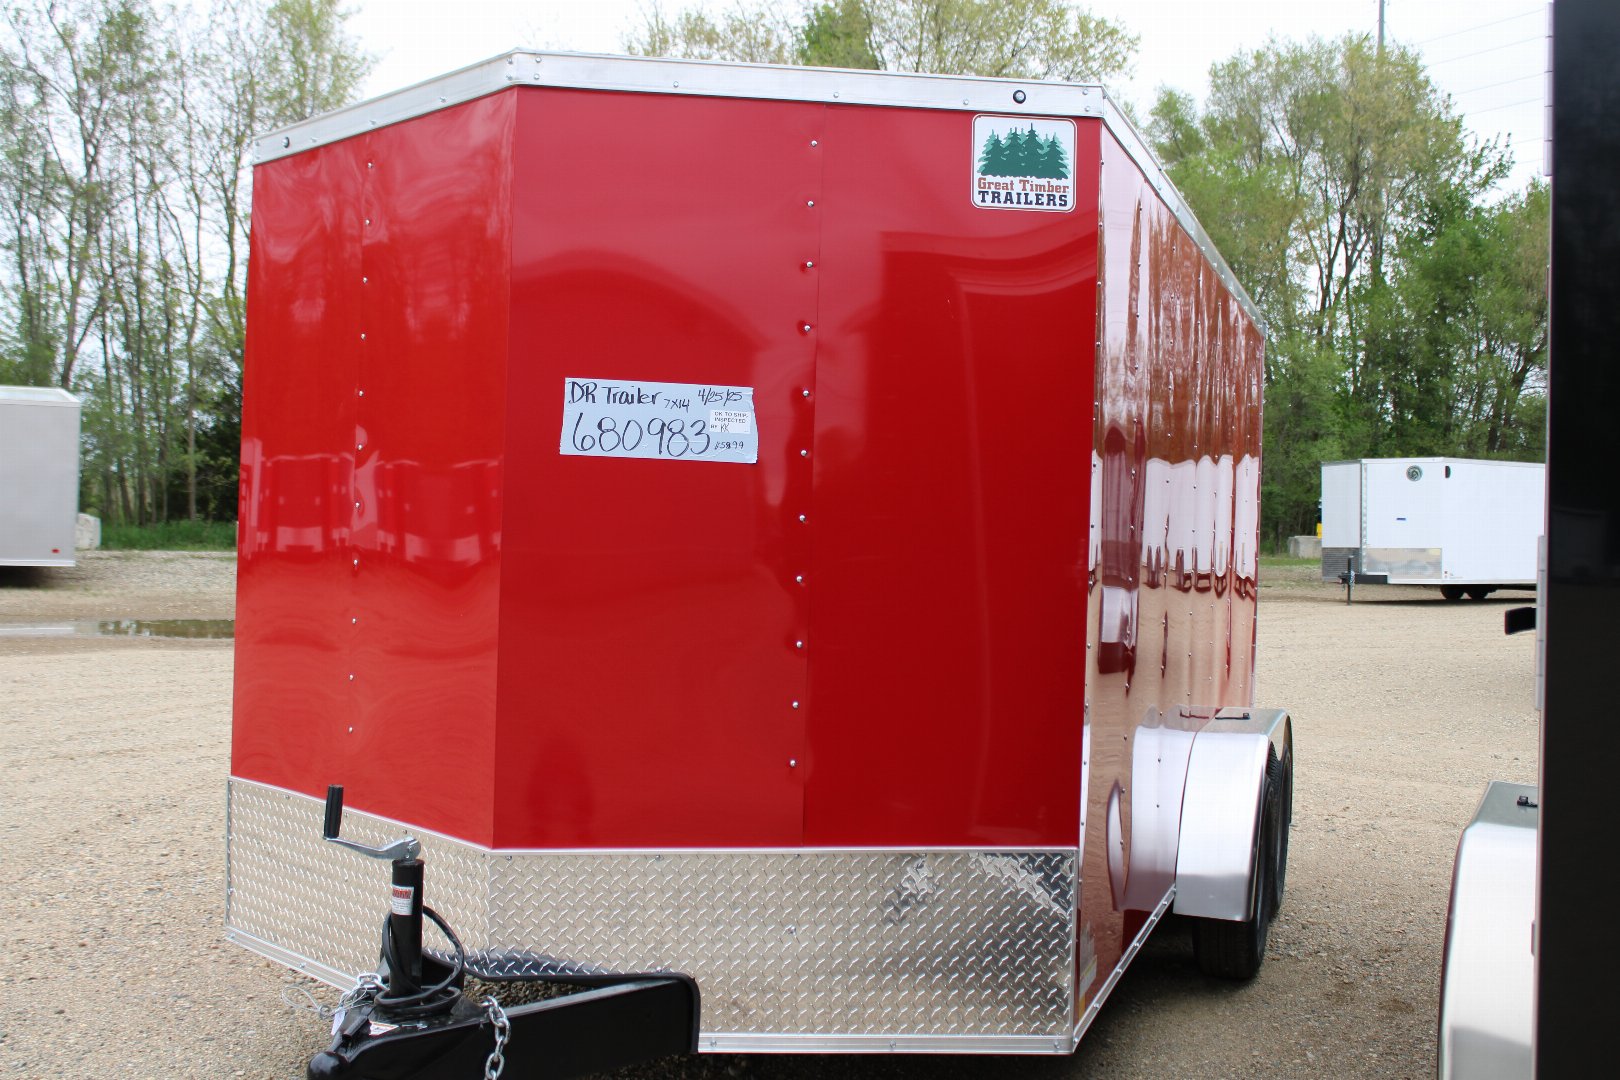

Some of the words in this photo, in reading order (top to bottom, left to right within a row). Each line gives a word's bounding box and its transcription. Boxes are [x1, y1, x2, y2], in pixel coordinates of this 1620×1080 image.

[977, 177, 1015, 191] Great
[1019, 179, 1070, 194] Timber
[978, 190, 1068, 207] TRAILERS
[568, 381, 598, 404] DR
[601, 385, 663, 405] Trailer
[698, 387, 743, 407] 4/25/25
[714, 416, 746, 424] INSPECTED
[572, 412, 711, 457] 680983
